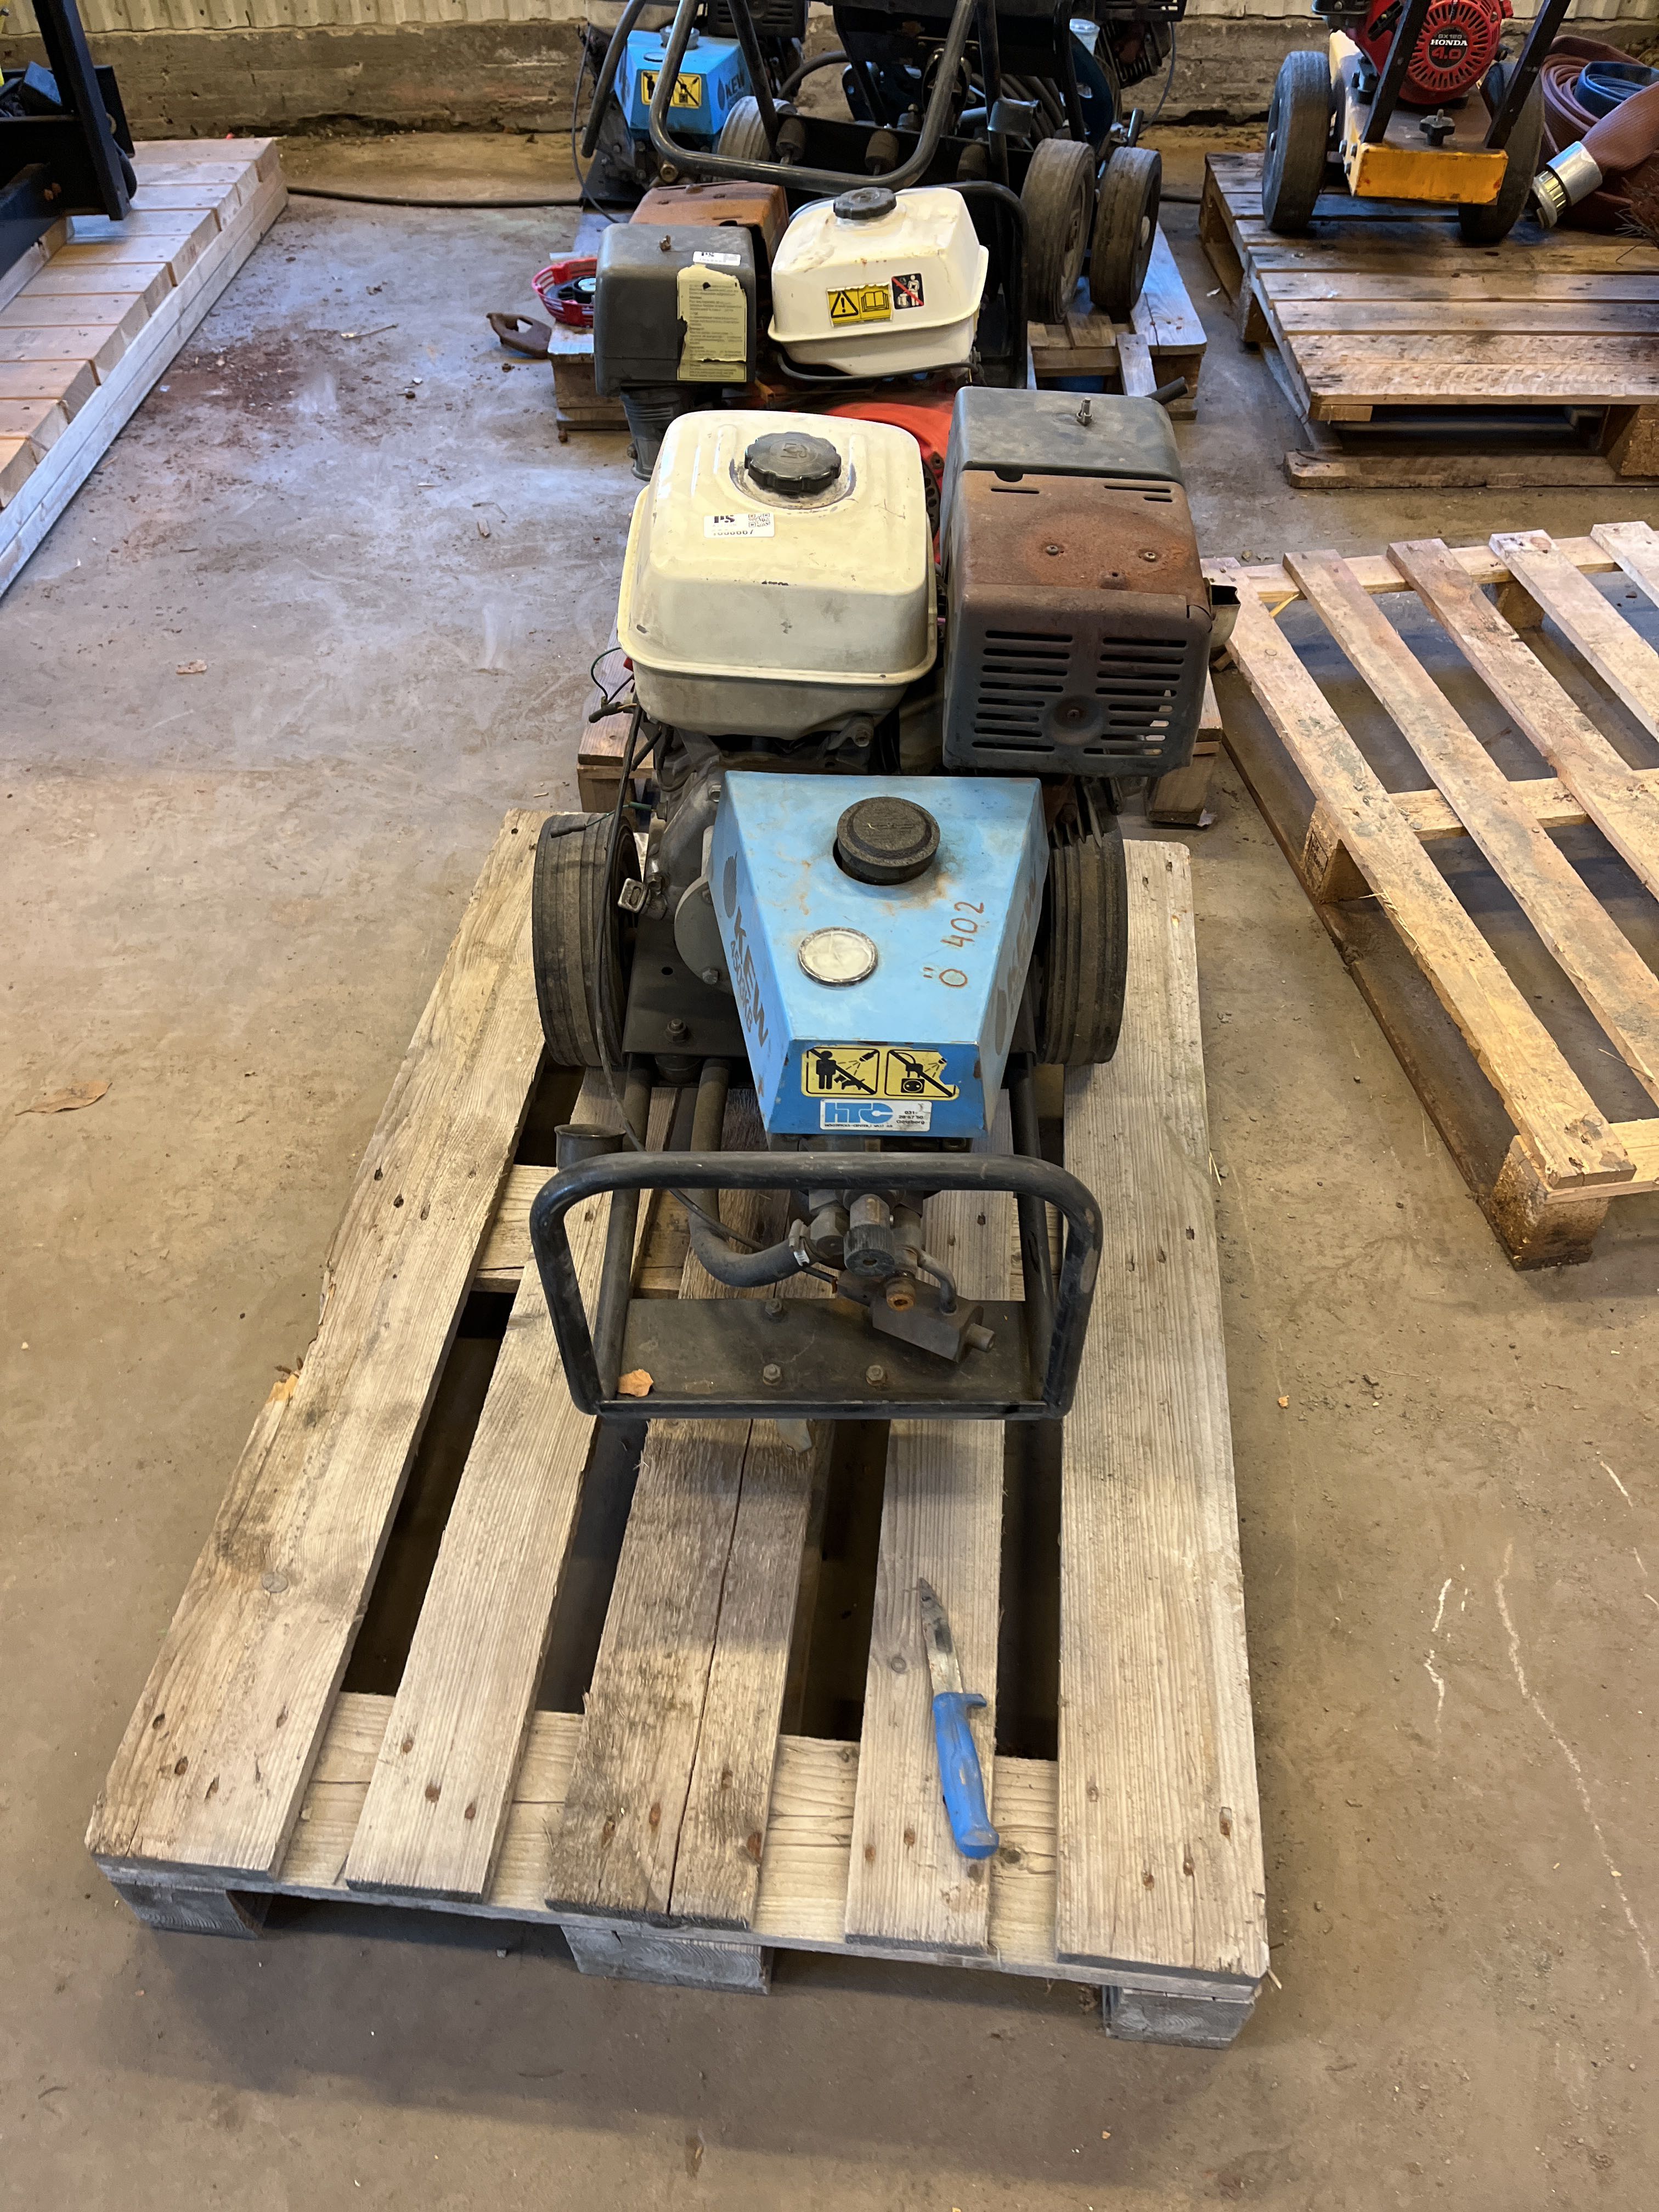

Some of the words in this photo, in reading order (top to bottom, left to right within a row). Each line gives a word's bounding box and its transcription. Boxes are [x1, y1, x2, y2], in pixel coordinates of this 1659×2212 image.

[1431, 47, 1462, 60] 4.0
[714, 515, 735, 523] PS
[940, 901, 985, 947] 402
[734, 905, 769, 1047] KEW
